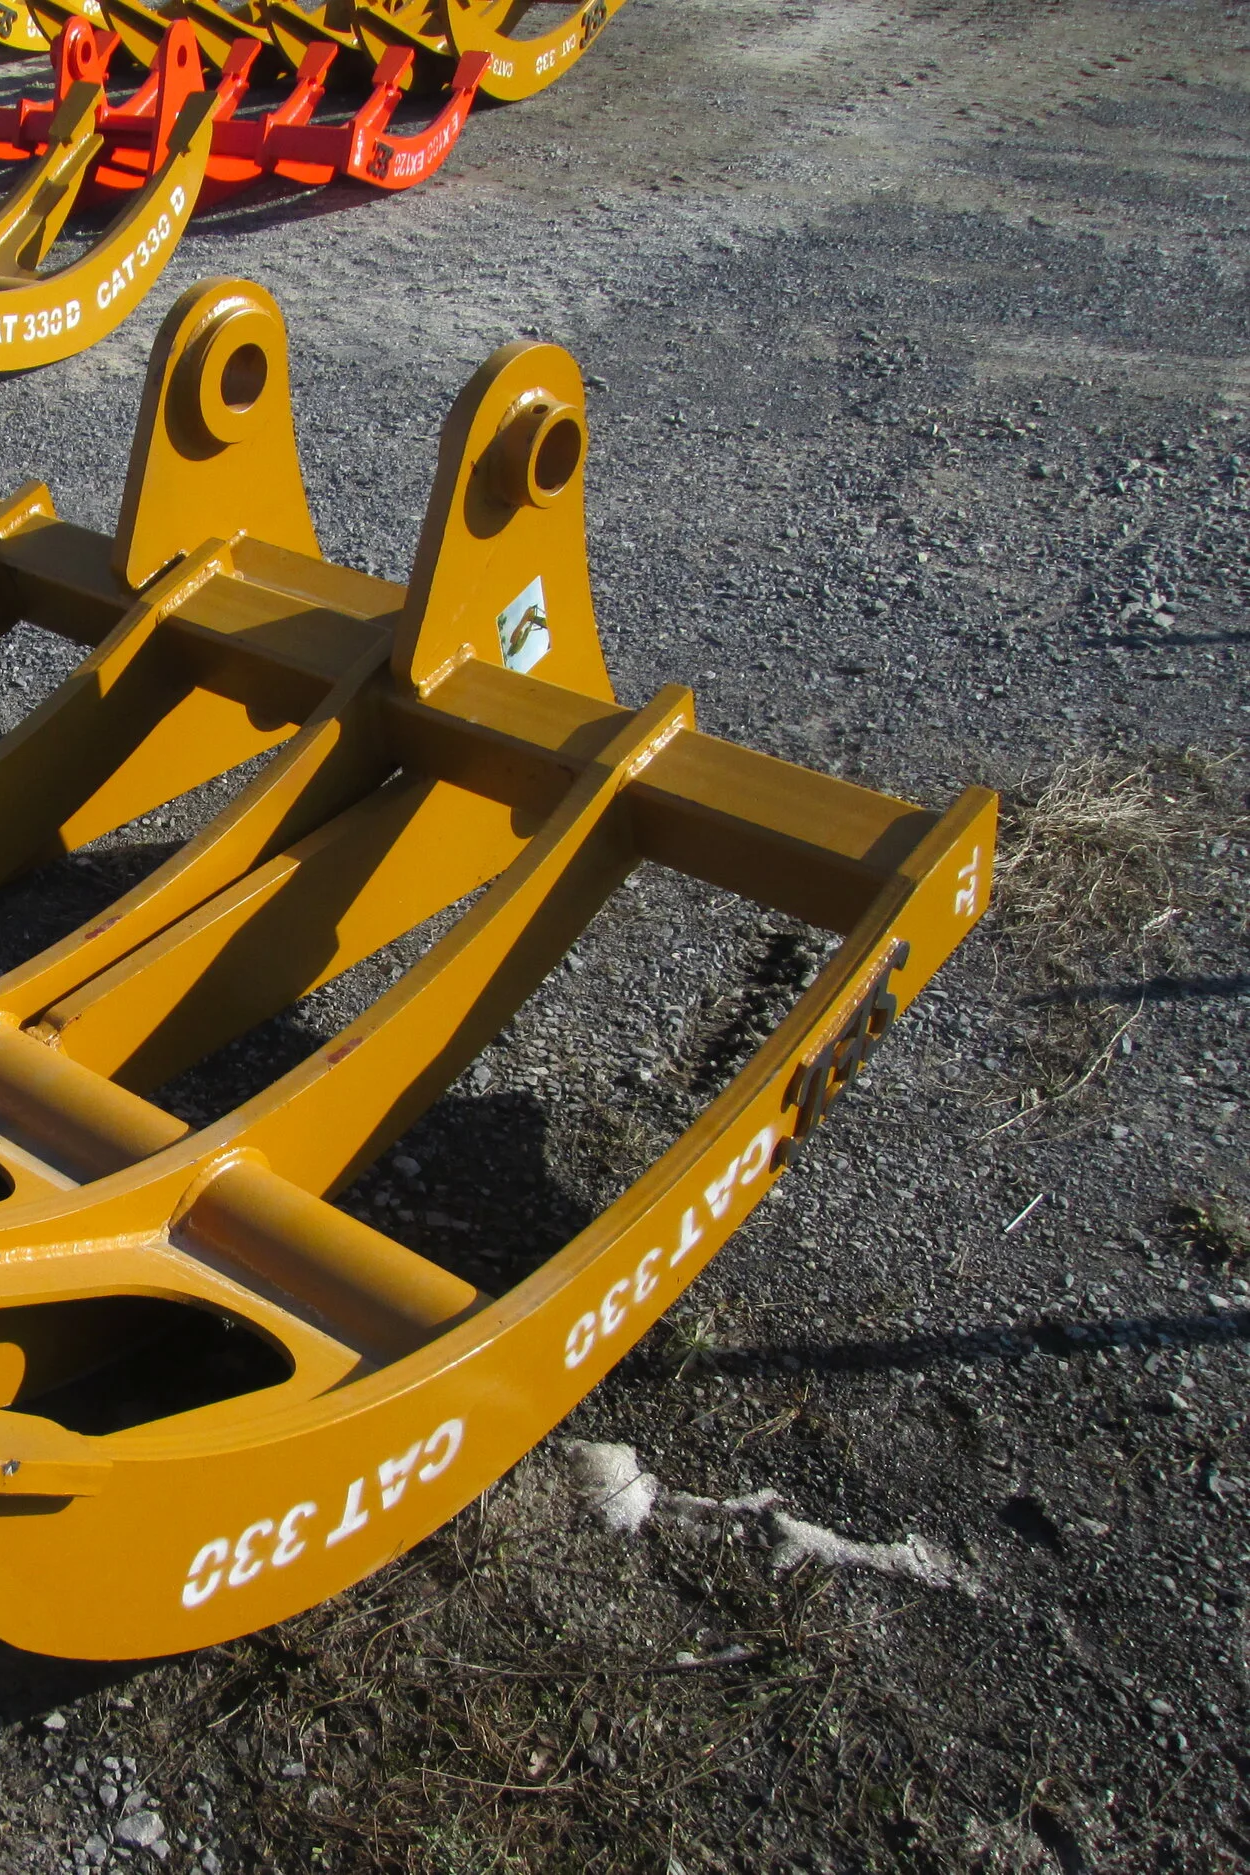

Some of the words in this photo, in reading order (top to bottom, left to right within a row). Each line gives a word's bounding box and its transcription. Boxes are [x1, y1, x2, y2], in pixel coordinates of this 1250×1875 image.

[669, 1125, 777, 1268] CAT
[564, 1247, 662, 1370] 330
[325, 1417, 464, 1549] CAT
[181, 1500, 318, 1609] 330
